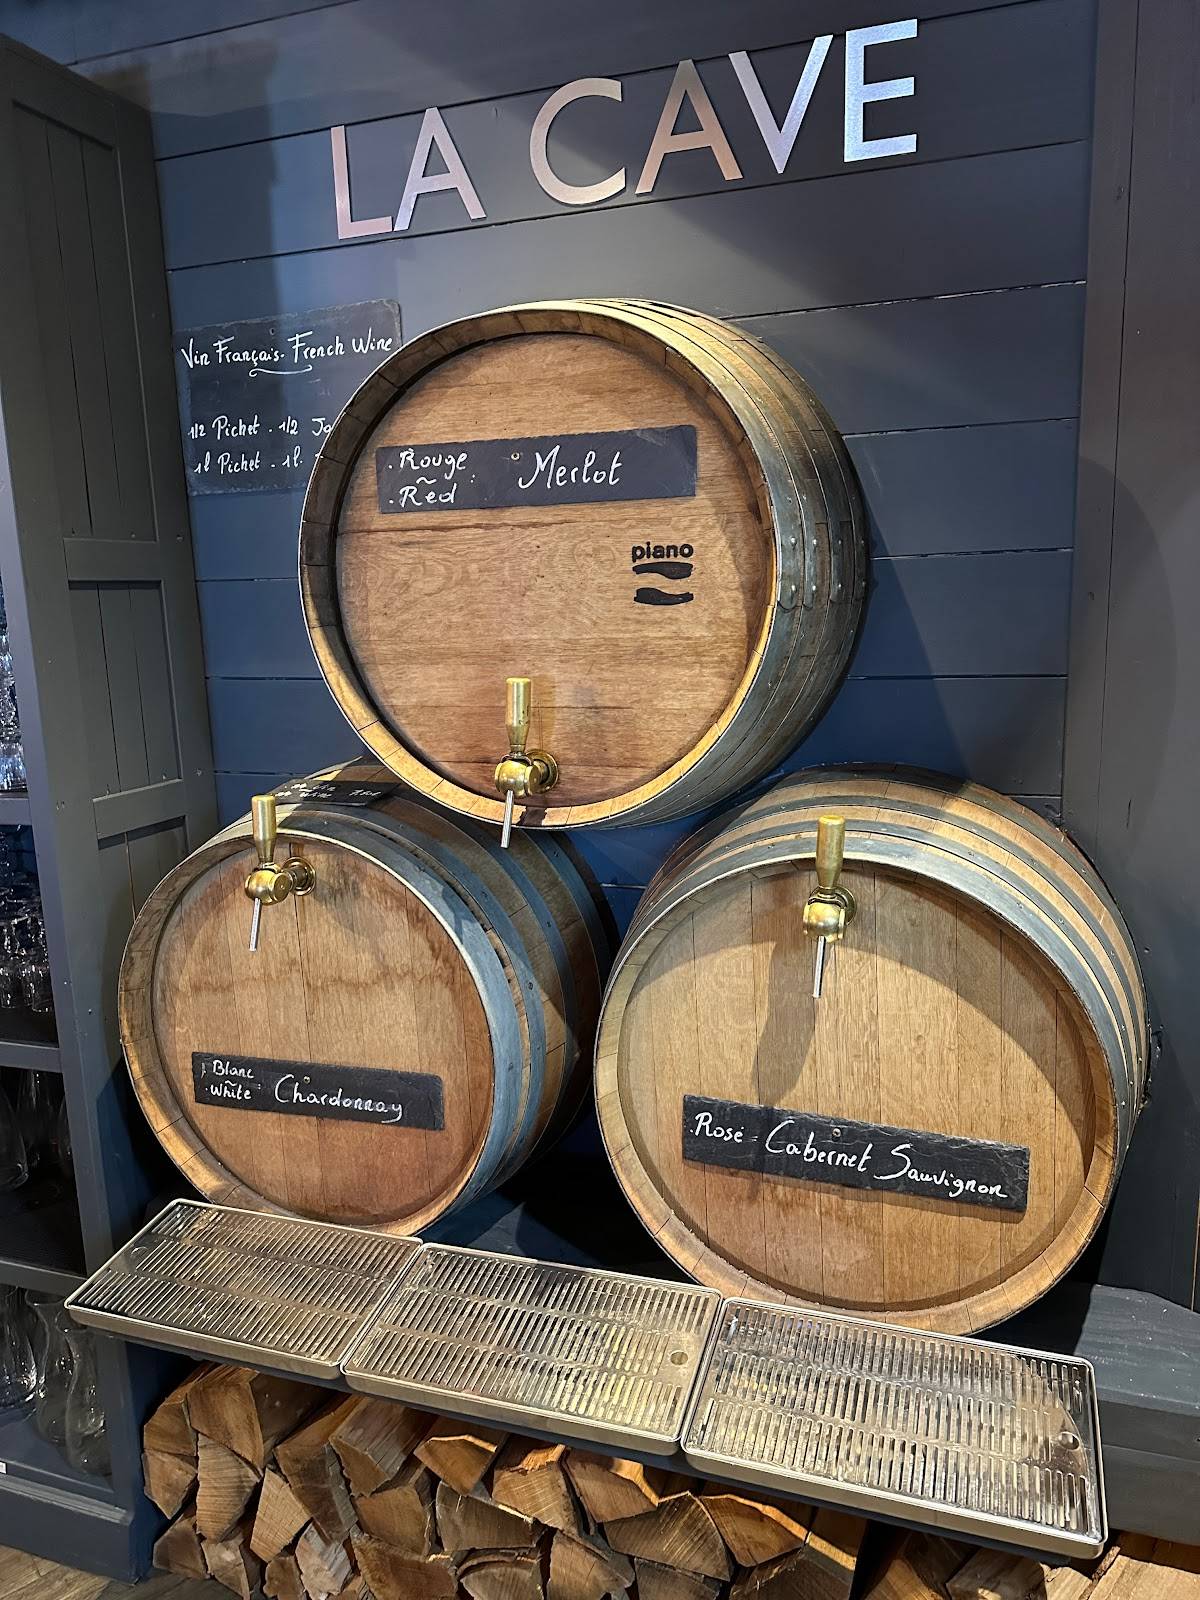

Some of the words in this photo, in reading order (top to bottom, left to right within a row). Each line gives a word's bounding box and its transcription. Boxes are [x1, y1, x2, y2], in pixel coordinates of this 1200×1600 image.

[330, 106, 487, 239] LA
[529, 18, 918, 206] CAVE
[181, 338, 210, 369] Vin
[287, 331, 345, 363] French
[351, 327, 393, 354] Wine
[212, 415, 261, 441] Pichet
[217, 451, 261, 475] Pichet
[518, 444, 624, 490] Merlot
[631, 540, 695, 563] piano
[210, 1080, 253, 1101] White
[274, 1073, 404, 1125] Chardonnay
[765, 1120, 873, 1173] Cabernet
[873, 1143, 1009, 1199] Sauvignon
